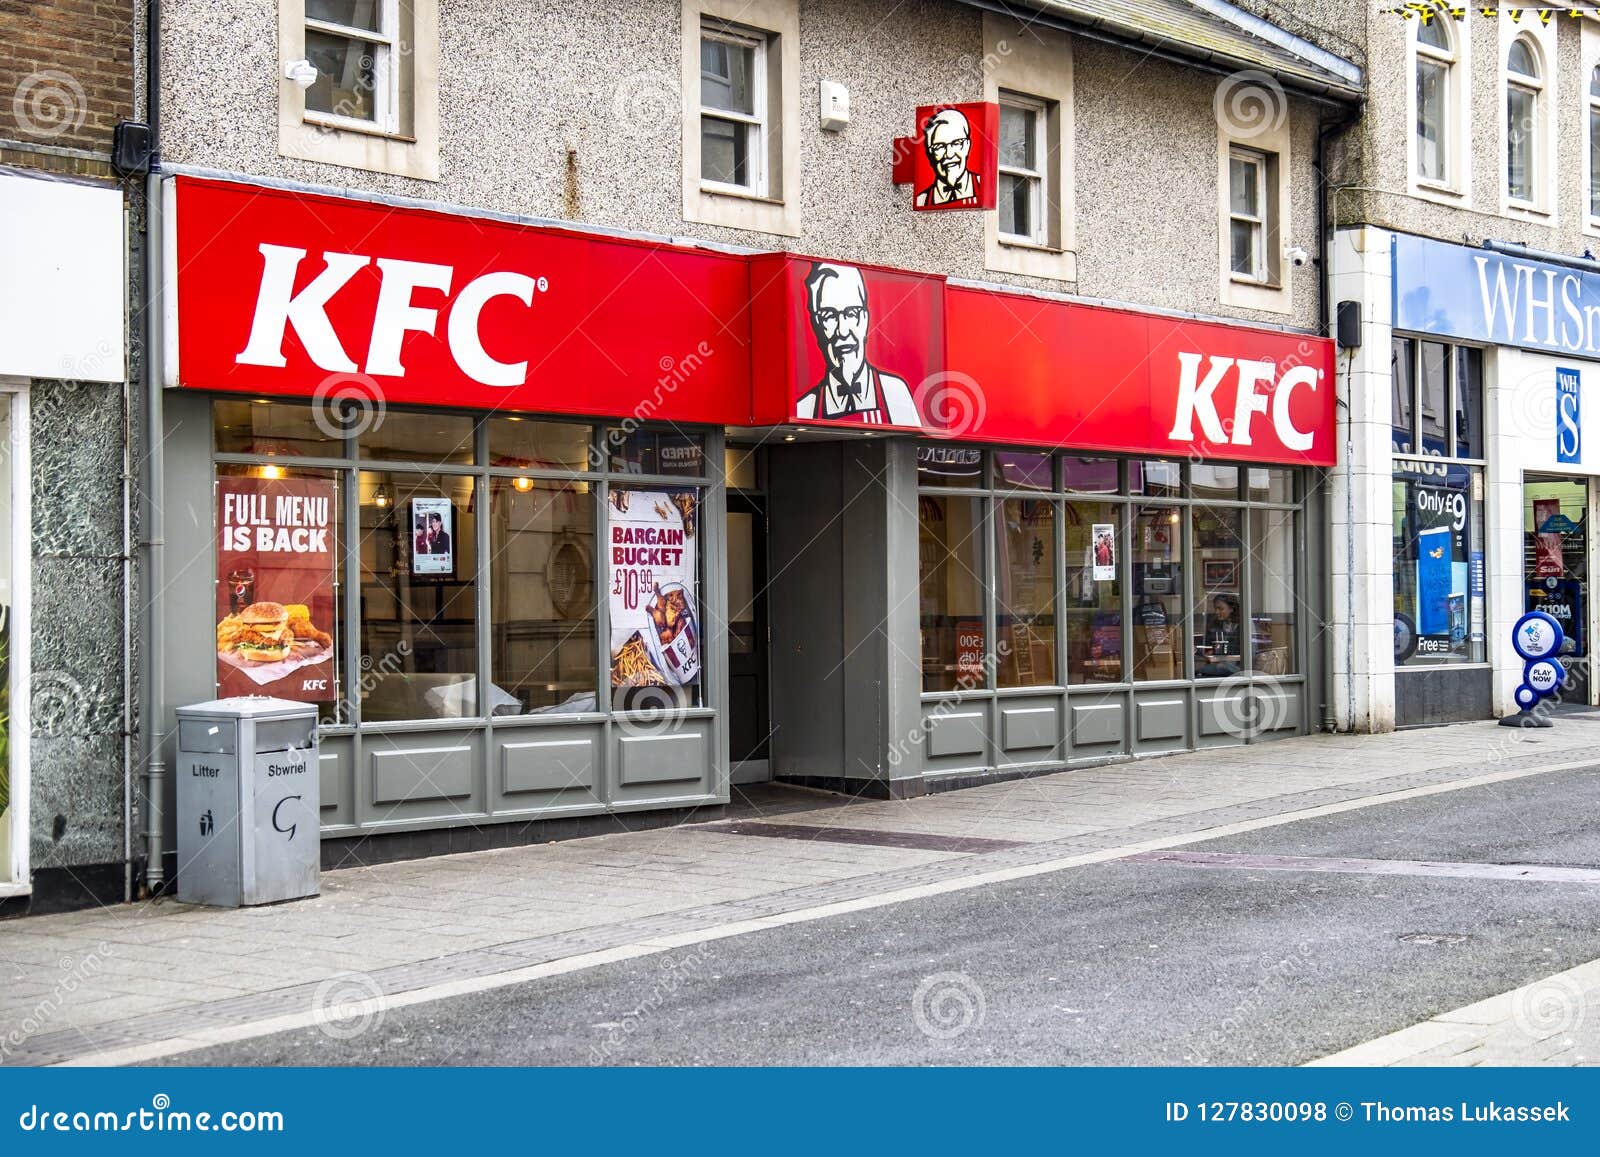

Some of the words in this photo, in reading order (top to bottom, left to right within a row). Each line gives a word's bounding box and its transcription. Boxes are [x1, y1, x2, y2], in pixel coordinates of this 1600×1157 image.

[1560, 374, 1577, 393] WH
[1560, 393, 1579, 457] S
[224, 493, 270, 526] FULL
[275, 495, 329, 527] MENU
[1418, 490, 1444, 515] Only
[223, 527, 252, 552] IS
[256, 527, 328, 553] BACK
[612, 526, 684, 546] BARGAIN
[612, 548, 683, 567] BUCKET
[1418, 637, 1438, 651] Free
[1532, 675, 1551, 683] NOW
[1533, 669, 1552, 677] PLAY
[302, 680, 327, 690] KFC
[192, 764, 220, 777] Litter
[268, 762, 307, 777] Sbwriel
